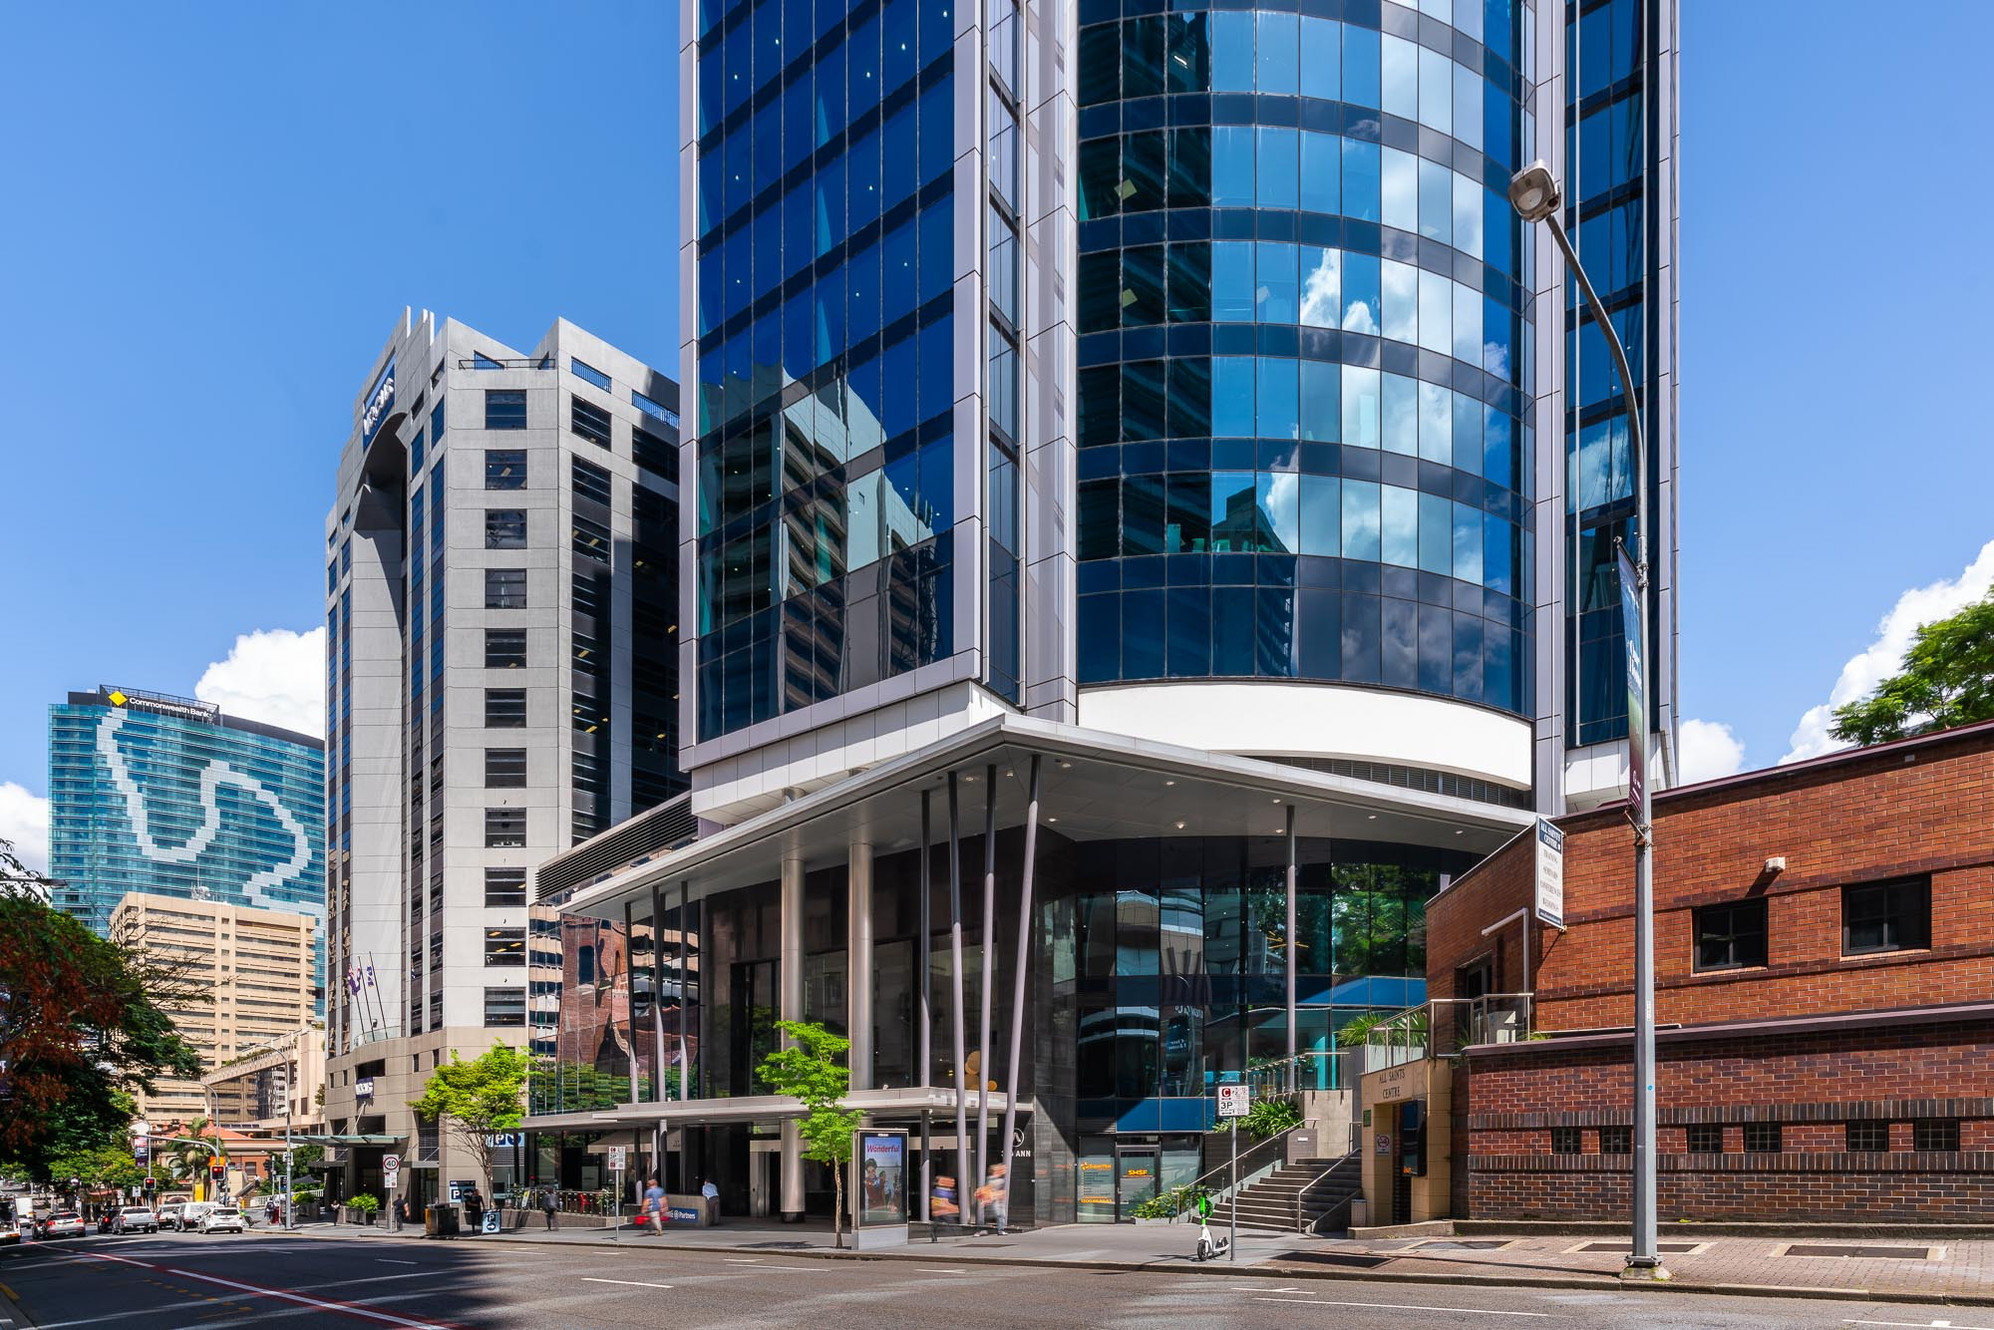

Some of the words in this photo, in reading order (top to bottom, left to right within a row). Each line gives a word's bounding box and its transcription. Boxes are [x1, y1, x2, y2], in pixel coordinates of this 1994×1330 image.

[129, 697, 190, 714] Commonwealth
[190, 708, 212, 719] Bank
[1379, 1072, 1387, 1083] ALL
[1383, 1086, 1400, 1099] CENTRE
[1221, 1102, 1233, 1110] 3P
[867, 1145, 899, 1153] Wonderful
[453, 1190, 460, 1199] P
